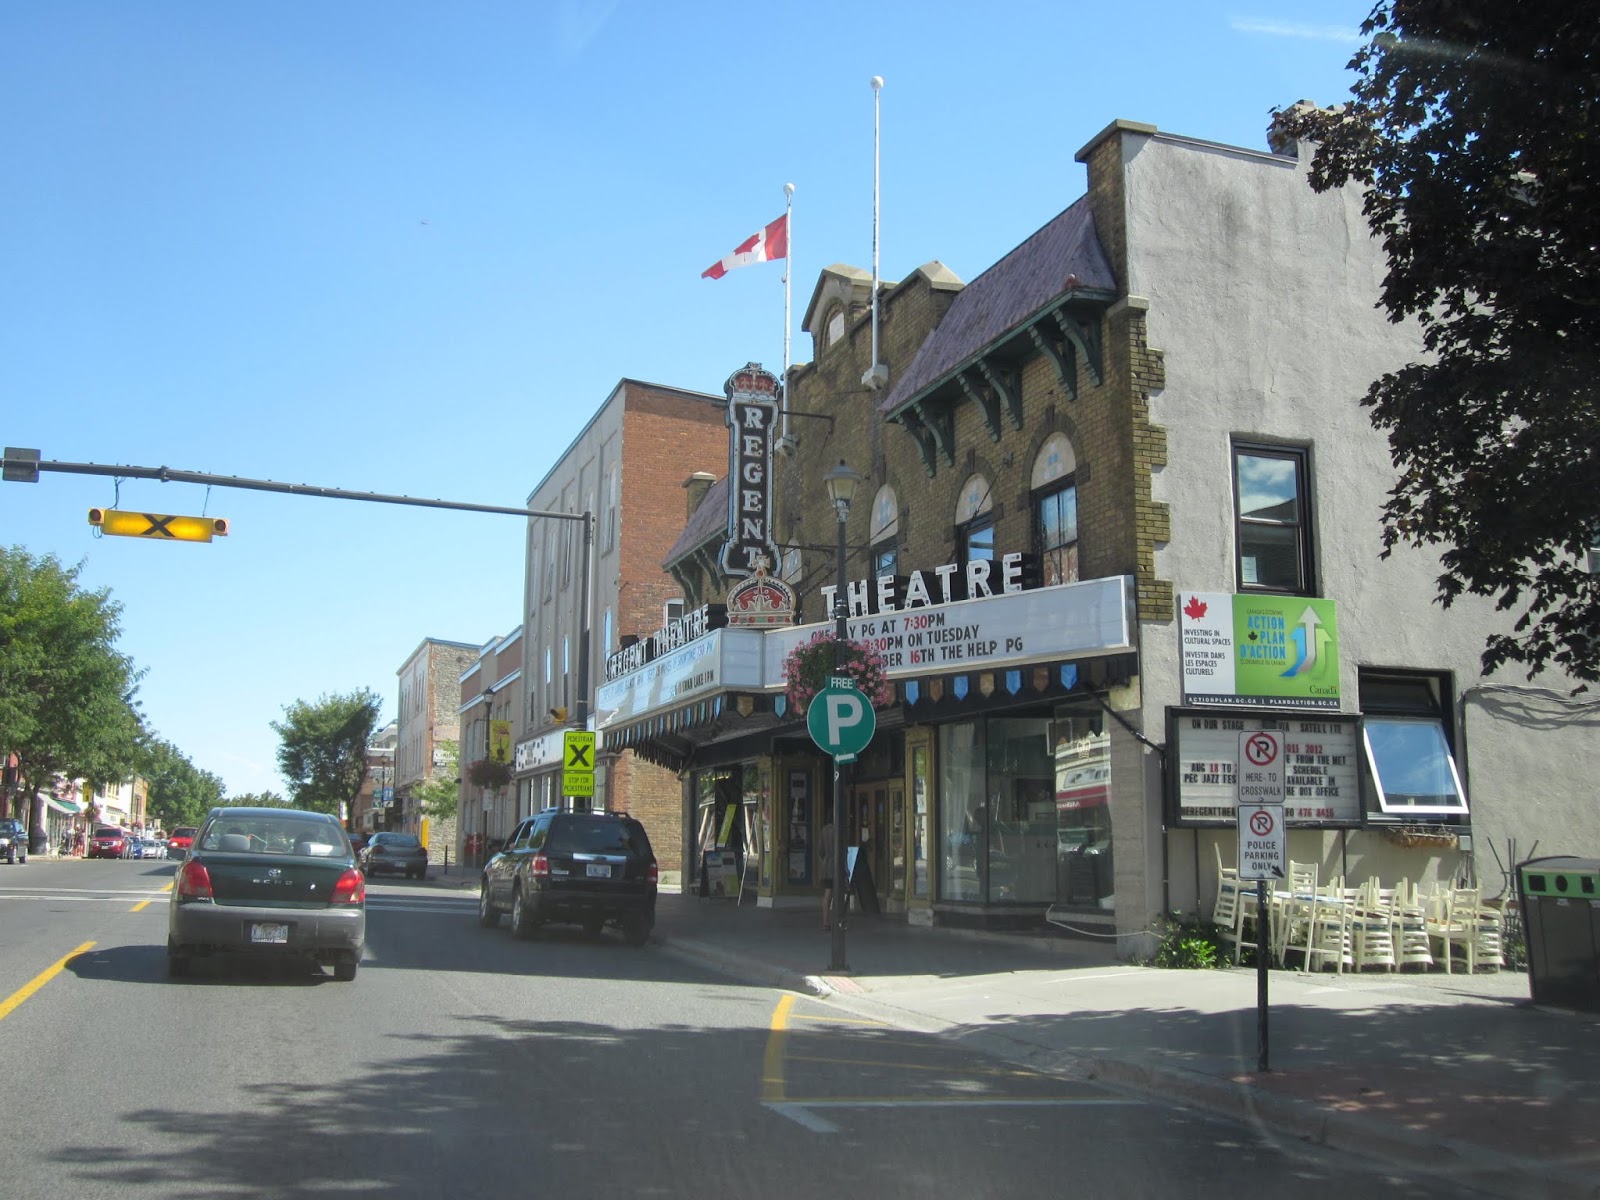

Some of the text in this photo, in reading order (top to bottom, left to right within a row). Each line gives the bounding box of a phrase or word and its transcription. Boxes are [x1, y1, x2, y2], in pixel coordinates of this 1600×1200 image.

[743, 406, 763, 568] REGENT
[820, 552, 1022, 621] THEATRE
[862, 623, 875, 637] PG
[882, 620, 896, 634] AT
[904, 613, 945, 631] 7:30PM
[1248, 615, 1285, 630] ACTION
[653, 603, 709, 658] THEATRE
[1184, 628, 1220, 637] INVESTING IN
[908, 632, 923, 648] ON
[927, 624, 979, 645] TUESDAY
[1260, 631, 1285, 644] PLAN
[1184, 637, 1231, 646] CULTURAL SPACES
[910, 648, 935, 664] 16TH
[941, 644, 963, 660] THE
[967, 640, 997, 657] HELP
[1005, 637, 1023, 653] PG
[1185, 651, 1225, 660] INVESTIR DANS
[1240, 644, 1286, 659] D'ACTION
[1196, 660, 1218, 668] ESPACES
[1186, 668, 1214, 676] CULTURELS
[830, 677, 853, 689] FREE
[1309, 684, 1338, 695] Canada
[826, 694, 863, 745] P
[1191, 719, 1245, 730] ON OUR STAGE
[566, 735, 593, 743] PEDESTRIAN
[1285, 744, 1323, 754] 011 2012
[1296, 755, 1314, 764] FROM
[1317, 755, 1330, 765] THE
[1332, 756, 1346, 765] MET
[1191, 763, 1205, 772] AUG
[1209, 763, 1219, 773] 18
[1222, 763, 1232, 773] TO
[1293, 765, 1328, 775] SCHEDULE
[1184, 774, 1237, 784] PEC JAZZ FES
[1245, 773, 1277, 782] HERE TO
[1286, 775, 1336, 786] AVAILABLE IN
[1241, 786, 1282, 796] CROSSWALK
[1286, 786, 1340, 797] HE BOX OFFICE
[1247, 841, 1276, 850] POLICE
[1244, 851, 1279, 860] PARKING
[1252, 861, 1272, 870] ONLY
